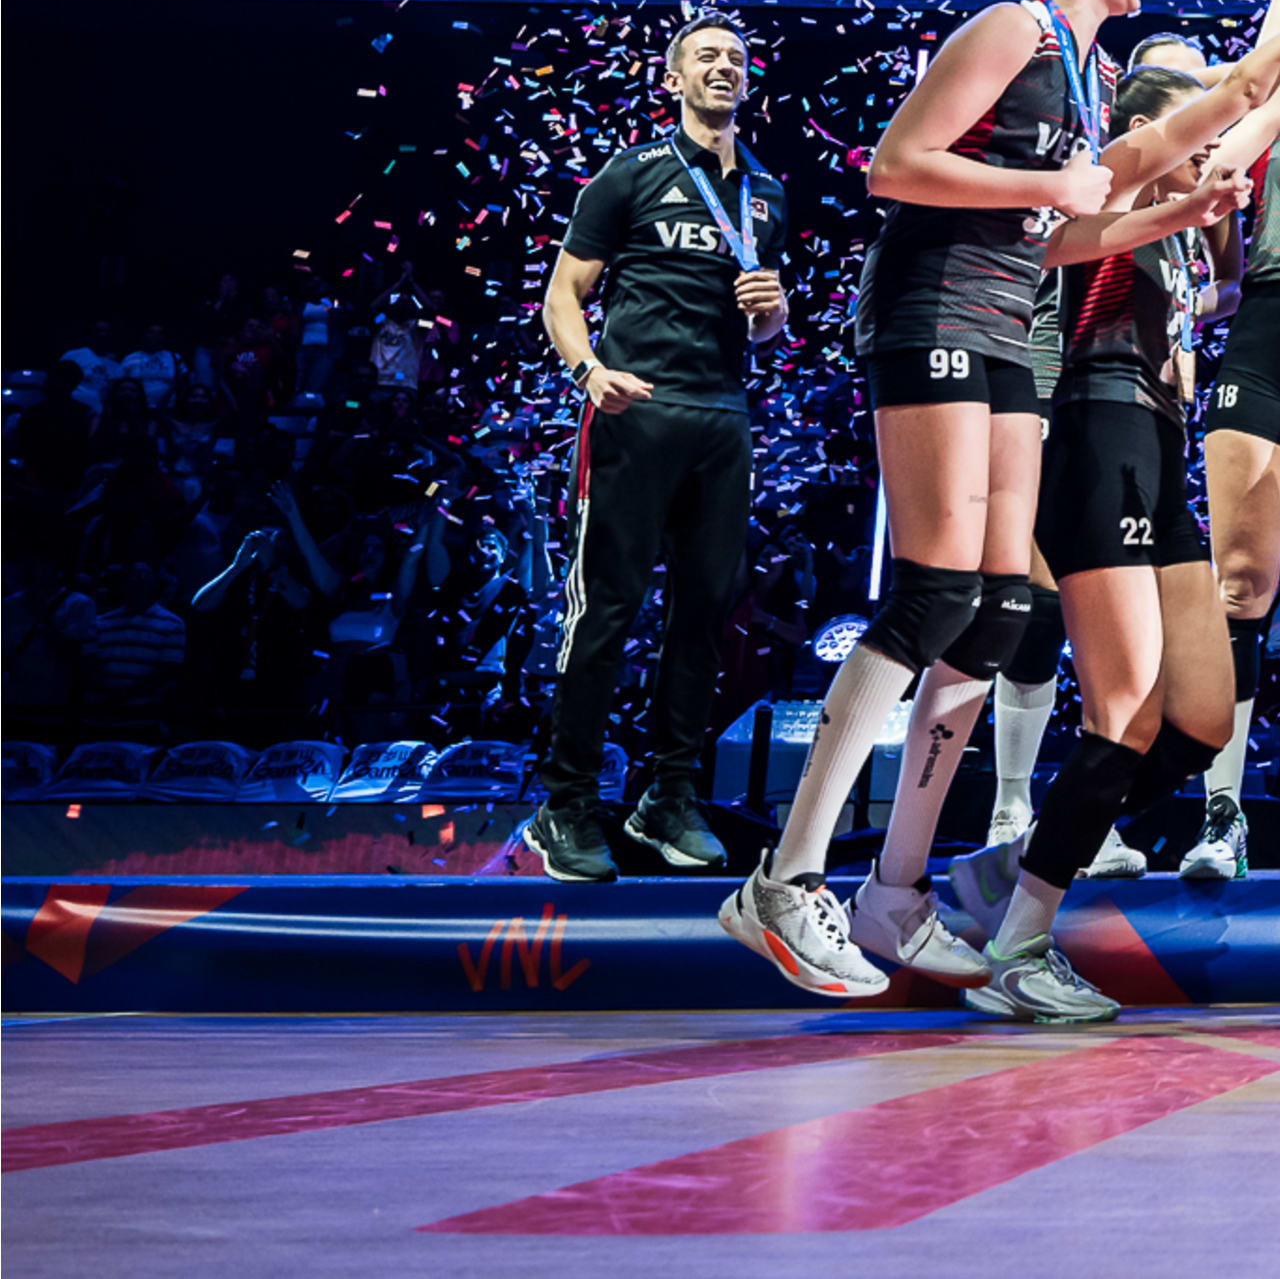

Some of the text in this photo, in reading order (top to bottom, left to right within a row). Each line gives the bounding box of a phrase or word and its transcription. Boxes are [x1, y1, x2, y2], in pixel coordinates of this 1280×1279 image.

[930, 348, 970, 380] 99
[1216, 384, 1239, 408] 18
[1119, 517, 1154, 545] 22
[457, 903, 591, 992] VNL
